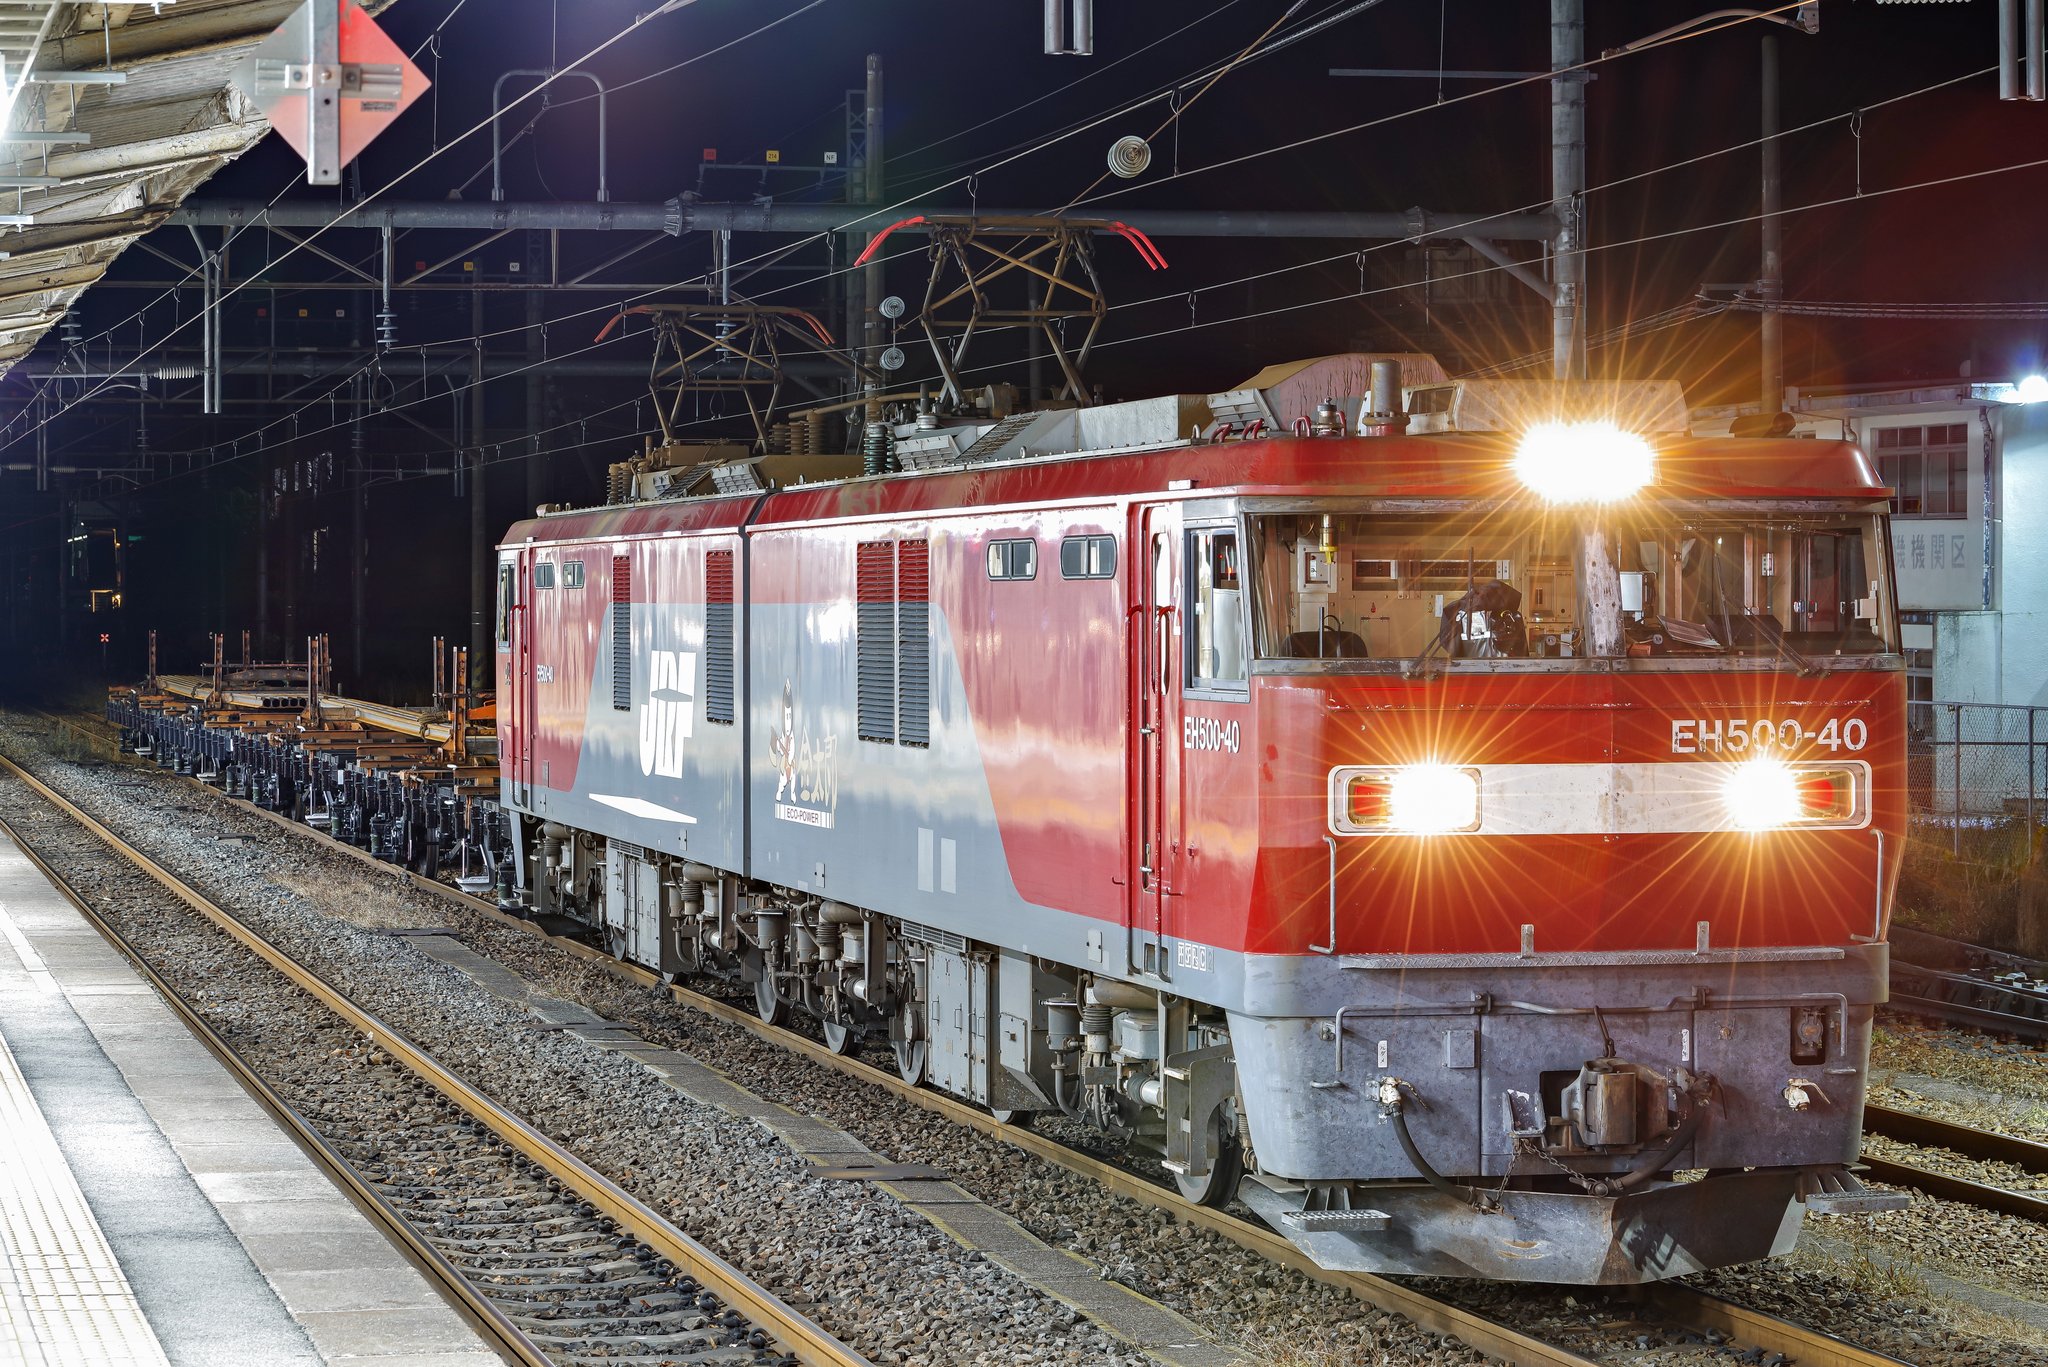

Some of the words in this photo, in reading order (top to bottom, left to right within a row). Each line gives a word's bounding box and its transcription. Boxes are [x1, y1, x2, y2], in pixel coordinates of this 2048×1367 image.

[639, 650, 697, 779] JRF
[1184, 716, 1240, 753] EH500-40
[1671, 718, 1868, 753] EH500-40
[786, 807, 819, 824] ECO-POWER
